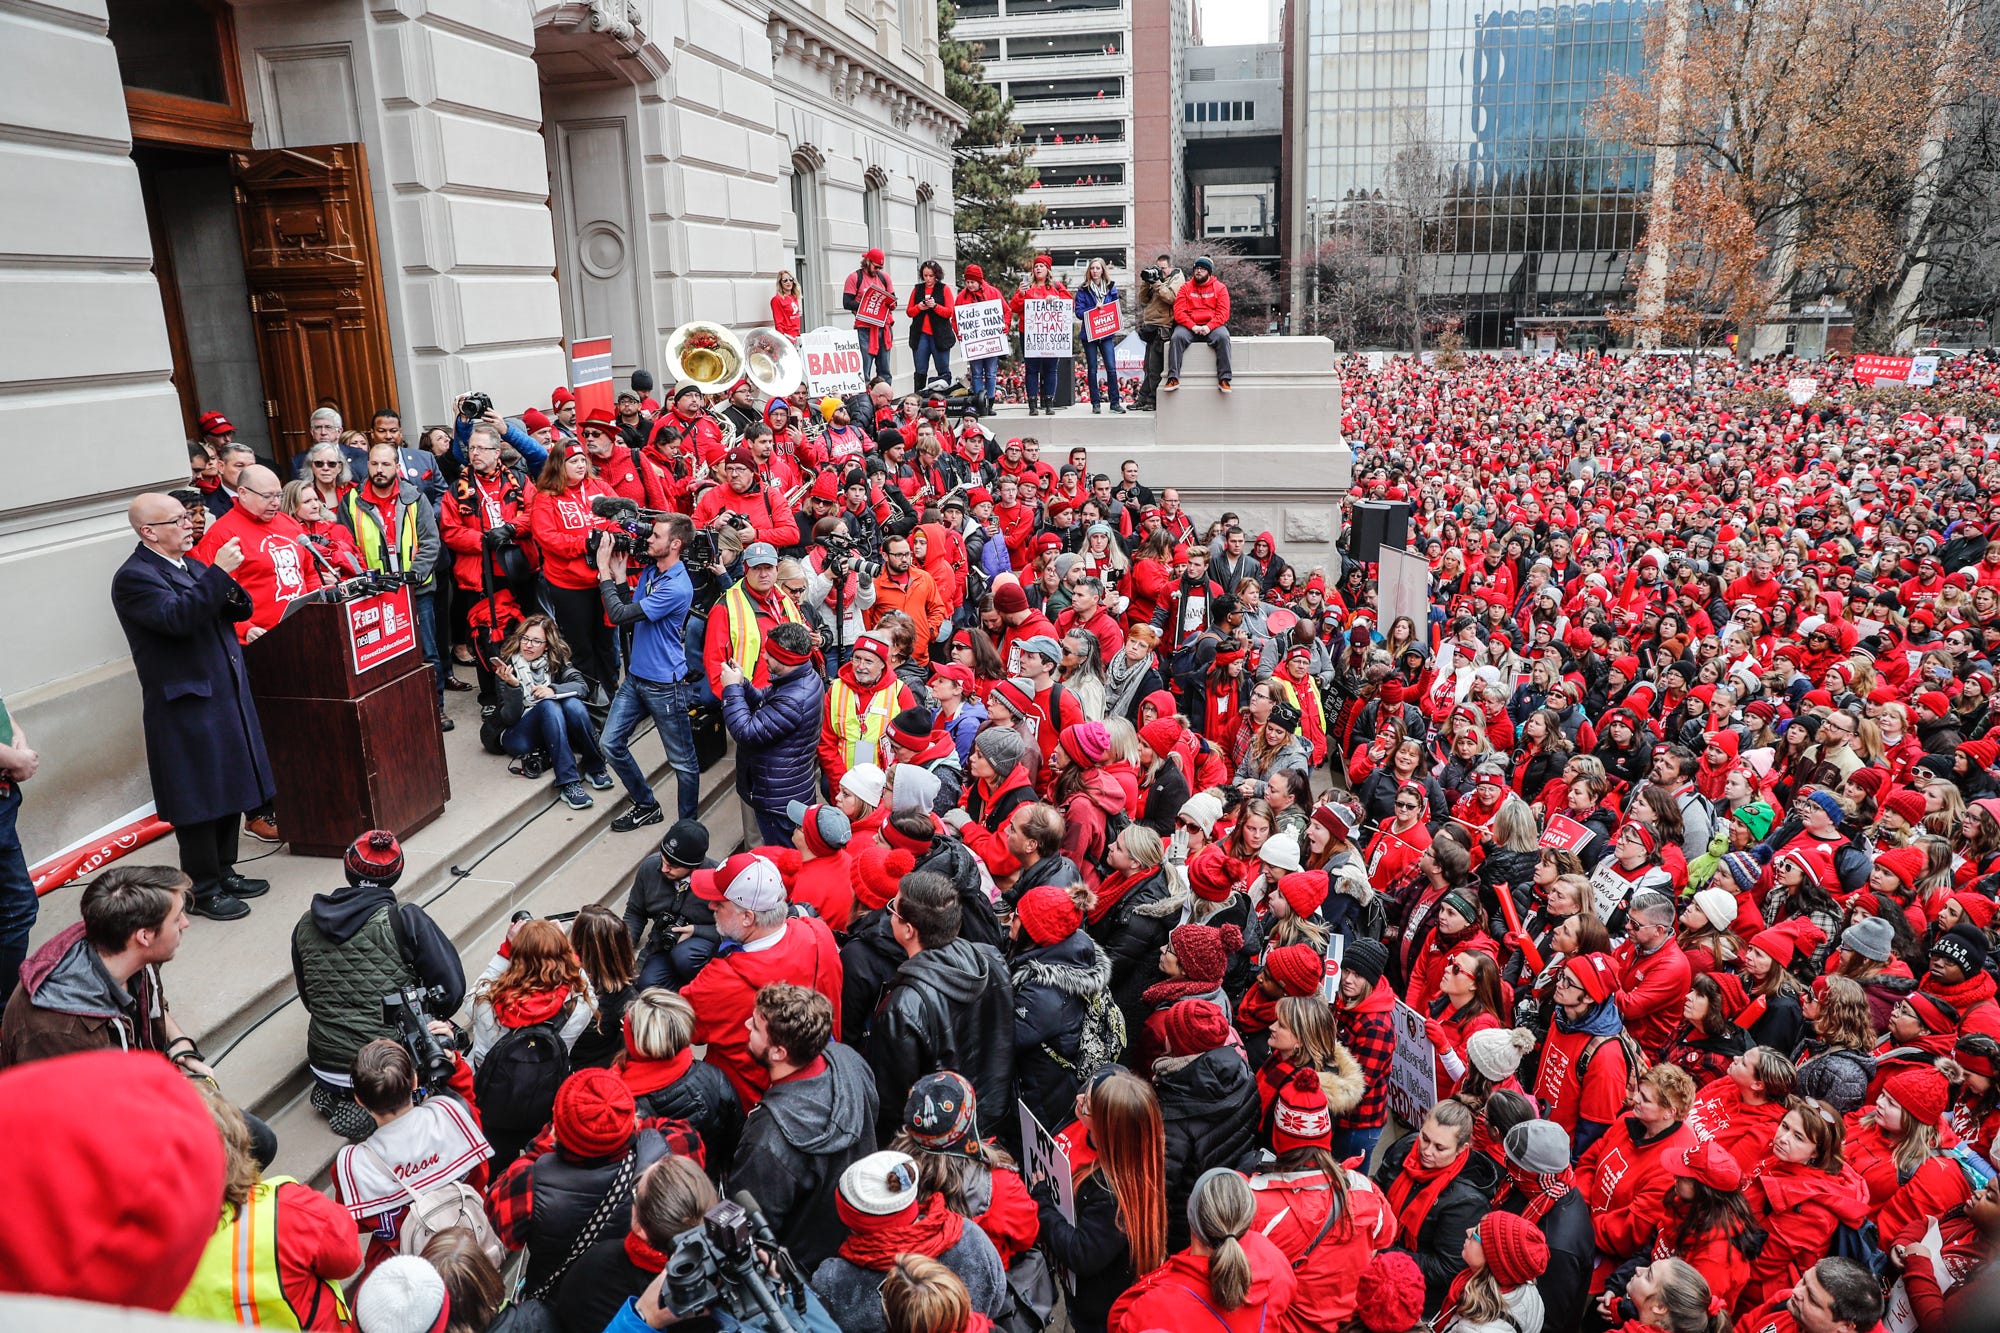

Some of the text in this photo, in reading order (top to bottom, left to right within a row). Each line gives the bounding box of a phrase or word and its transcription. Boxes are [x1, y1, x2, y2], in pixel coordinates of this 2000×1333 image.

[1032, 301, 1064, 312] TEACHER
[958, 307, 1000, 321] Kids are
[1034, 312, 1063, 322] MORE
[1093, 314, 1115, 327] WHAT
[958, 315, 1004, 332] MORE THAN
[1035, 322, 1063, 333] THAN
[1033, 333, 1048, 343] TEST
[1050, 333, 1069, 343] SCORE
[807, 351, 861, 376] BAND
[1859, 357, 1912, 368] PARENTS
[812, 381, 862, 394] Together
[76, 846, 112, 877] KIDS
[1599, 868, 1616, 887] When
[393, 1153, 439, 1180] Olson
